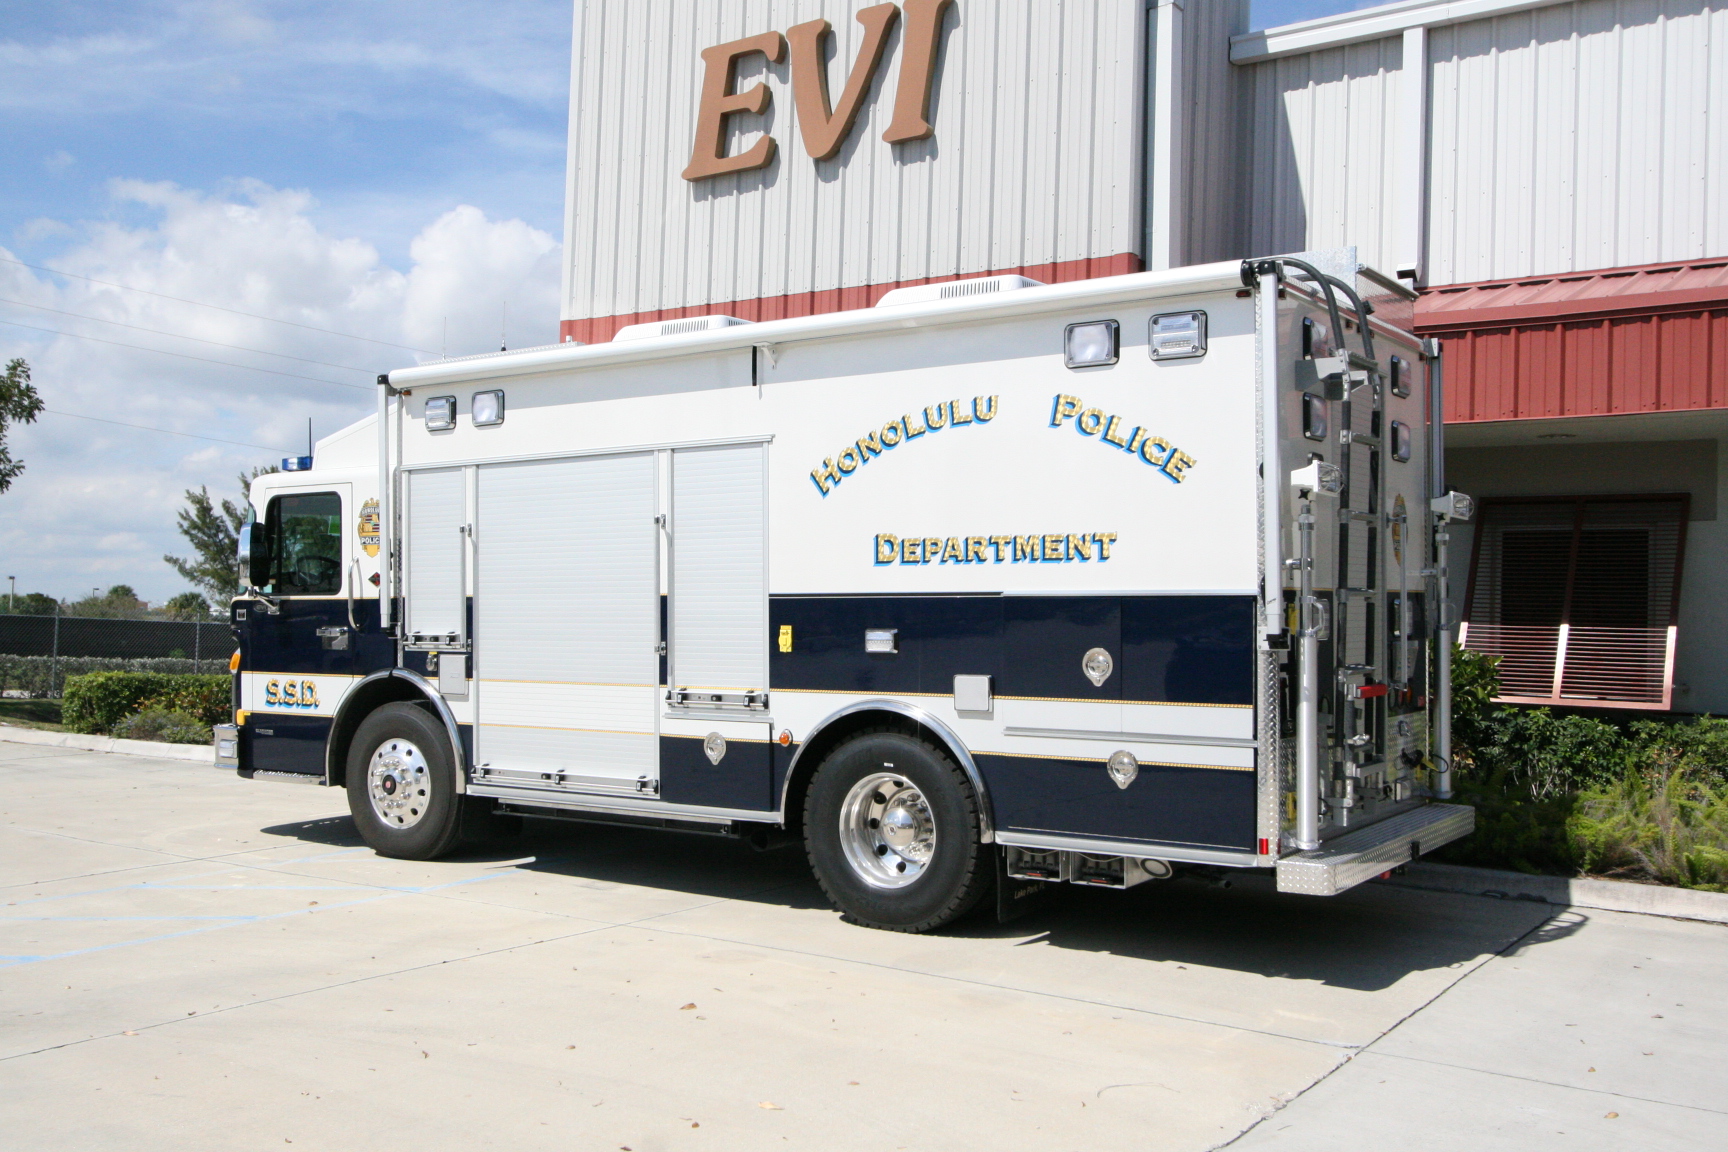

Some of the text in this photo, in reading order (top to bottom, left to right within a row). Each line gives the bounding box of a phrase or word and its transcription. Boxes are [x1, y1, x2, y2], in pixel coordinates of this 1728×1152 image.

[681, 0, 956, 182] EVI
[810, 393, 1198, 499] HONOLULU POLICE
[361, 537, 380, 545] POLIC
[873, 531, 1118, 567] DEPARTMENT
[265, 678, 320, 709] S.S.D.
